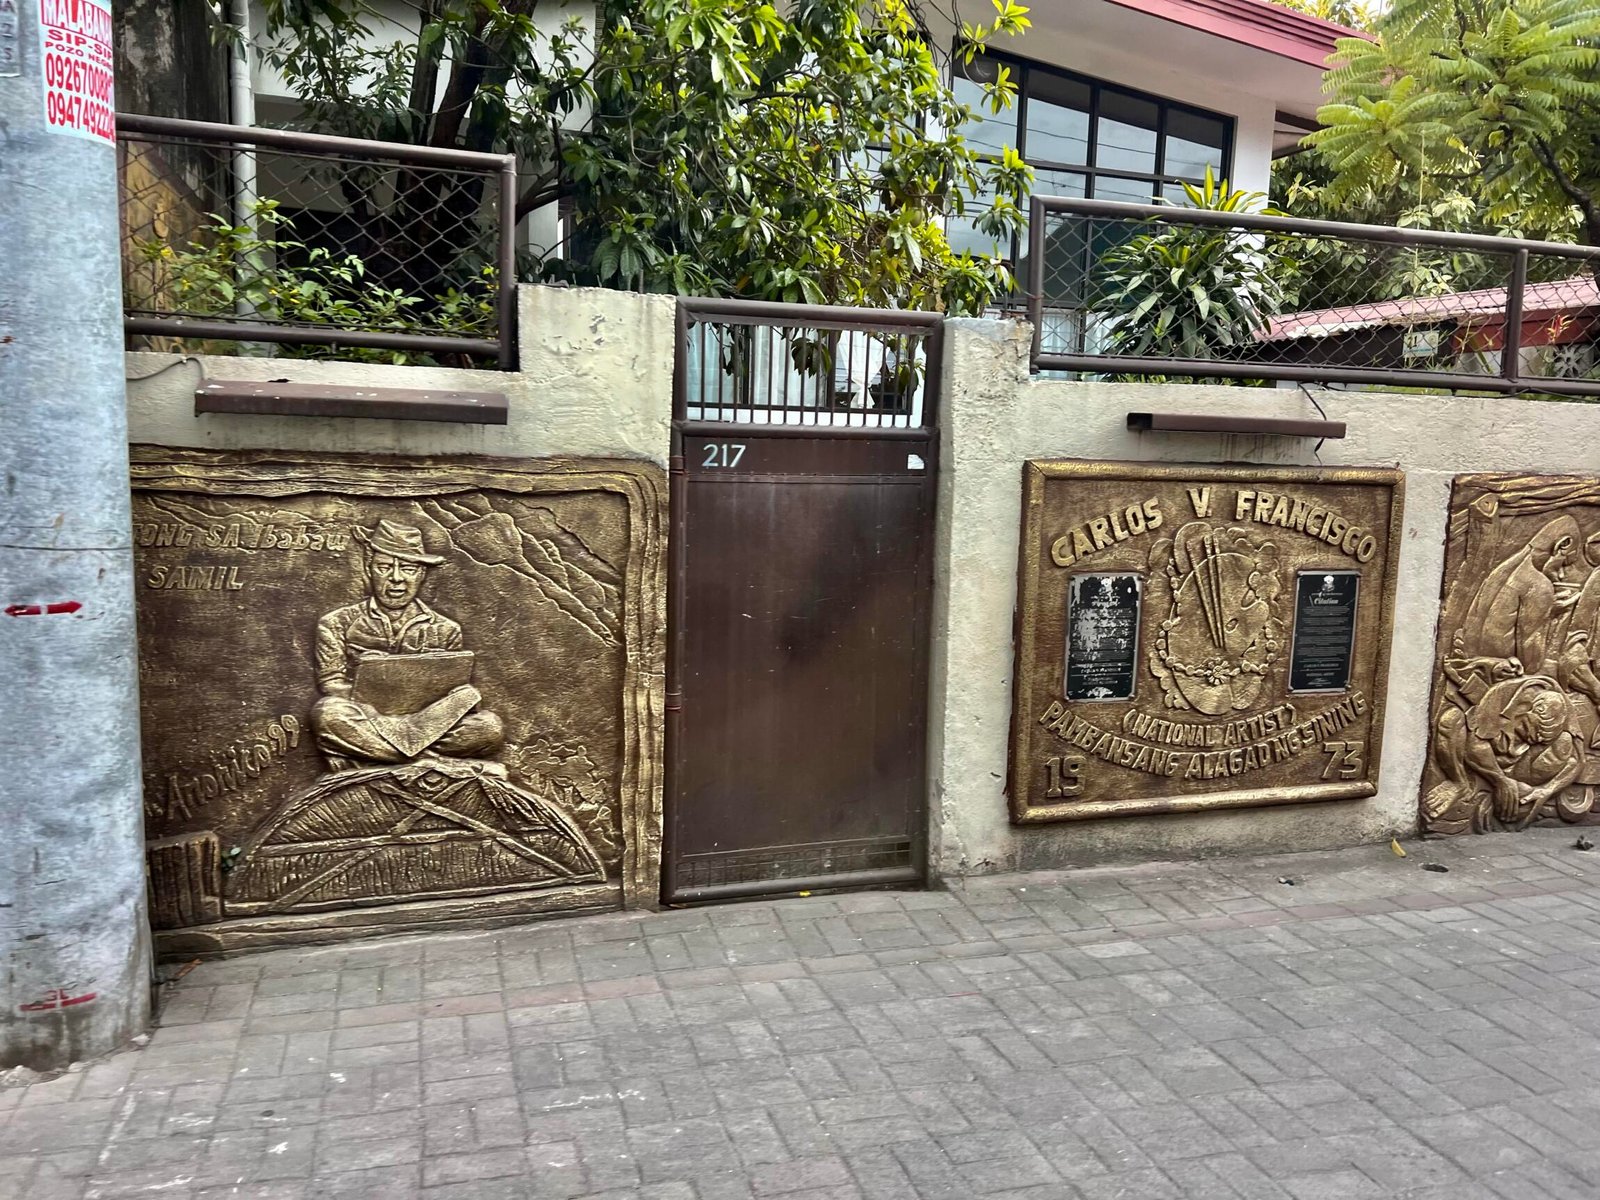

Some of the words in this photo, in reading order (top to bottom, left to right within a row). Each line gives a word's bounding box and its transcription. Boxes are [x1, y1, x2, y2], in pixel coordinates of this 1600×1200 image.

[45, 41, 84, 57] POZO
[702, 443, 747, 468] 217
[205, 523, 240, 547] SA
[1050, 496, 1163, 567] CARLOS
[1188, 487, 1212, 518] V.
[1235, 490, 1377, 563] FRANCISCO
[147, 565, 244, 590] SAMIL
[1038, 700, 1179, 777] PAMBANSANG
[1184, 742, 1272, 779] ALAGAD
[1272, 730, 1300, 763] NG
[1301, 690, 1368, 745] SINING
[1123, 708, 1216, 747] (NATIONAL
[1224, 702, 1296, 746] ARTIST)
[1320, 741, 1365, 780] 73
